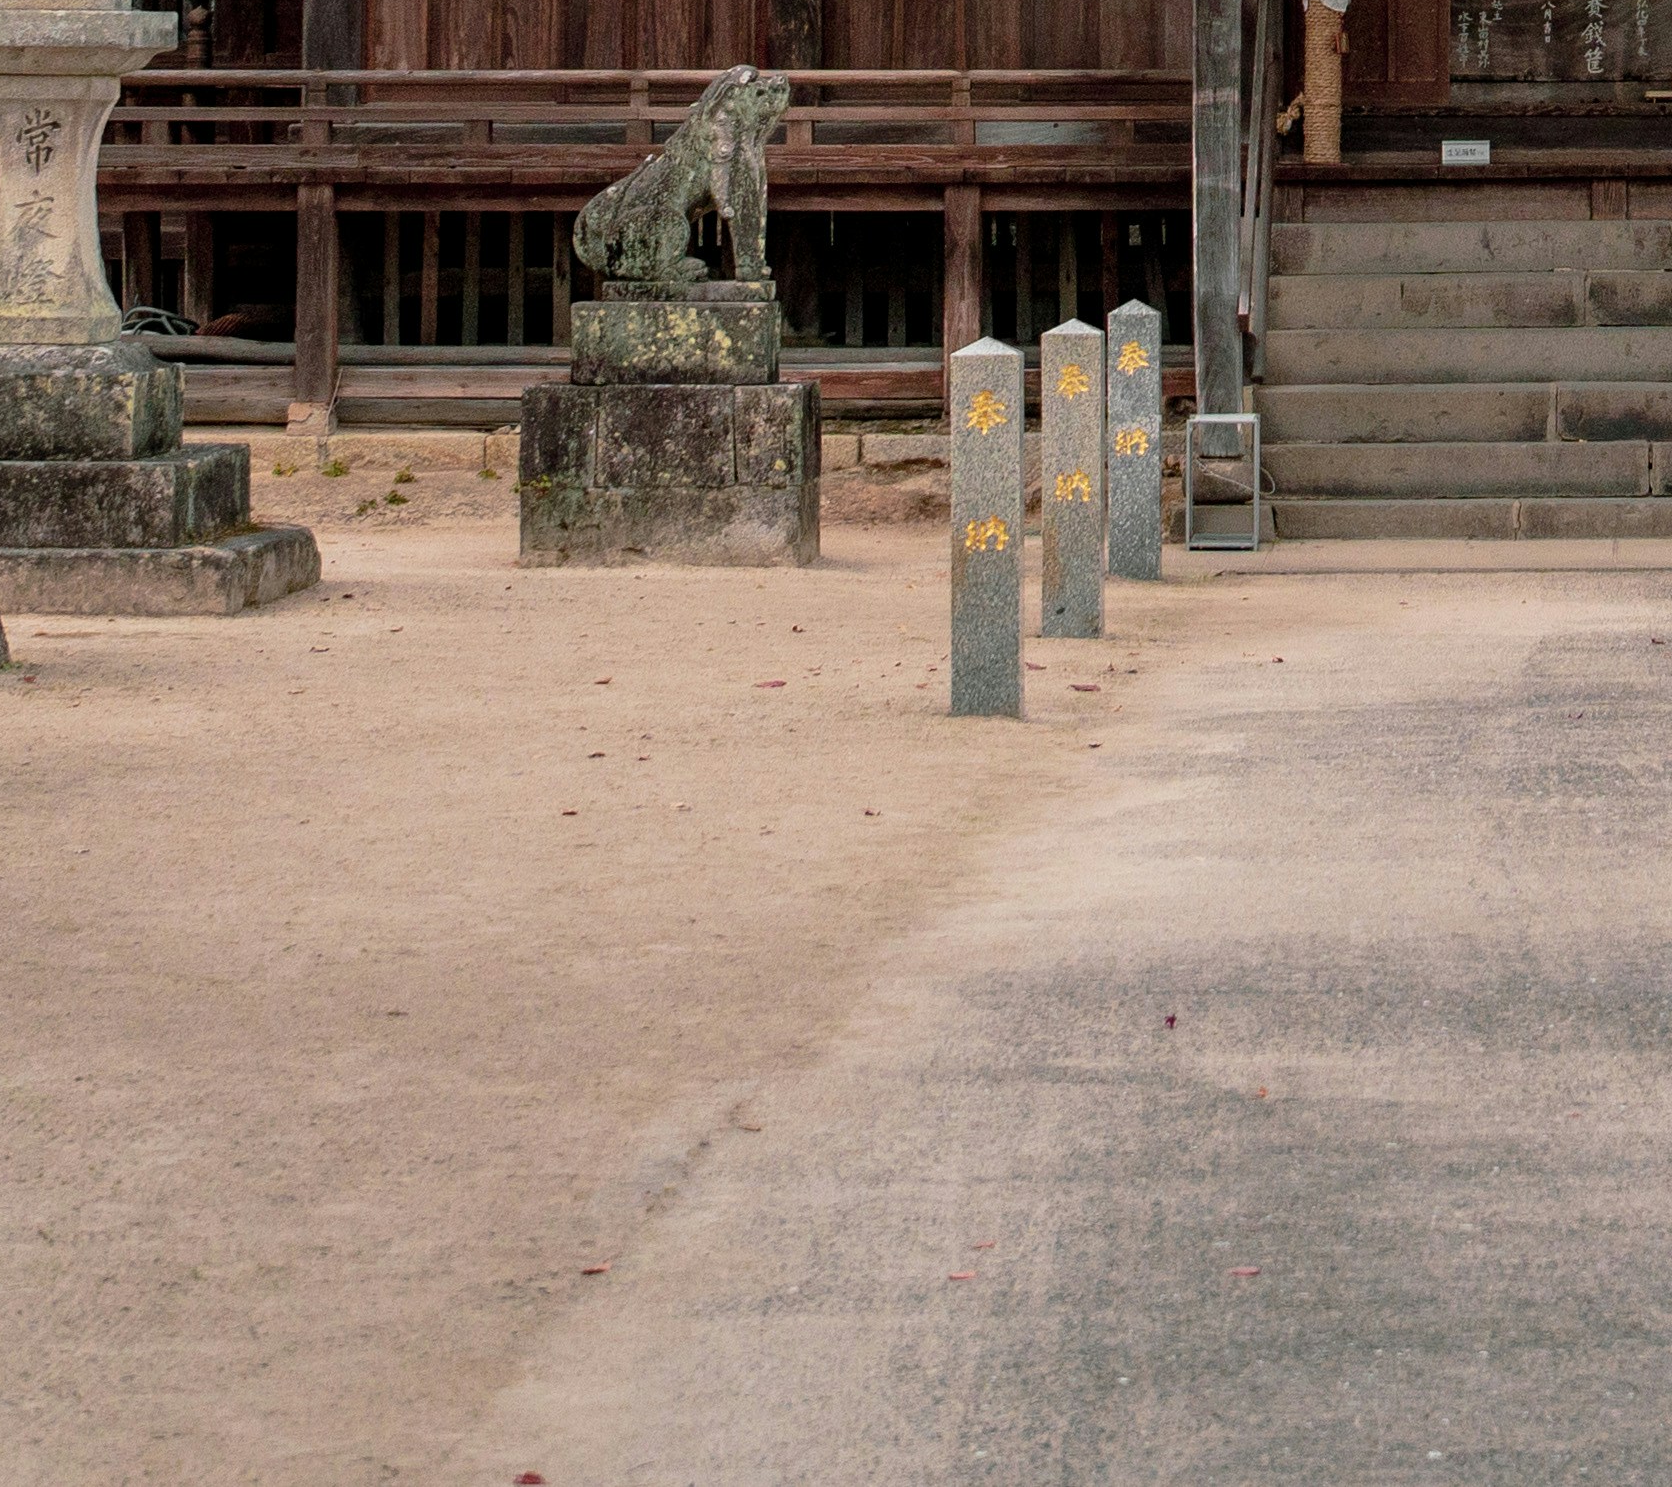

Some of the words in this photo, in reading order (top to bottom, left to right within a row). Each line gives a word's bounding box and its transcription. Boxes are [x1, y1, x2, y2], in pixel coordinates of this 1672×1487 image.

[1055, 363, 1092, 502] 奉納
[1115, 340, 1150, 457] 奉納
[965, 389, 1010, 554] 奉納
